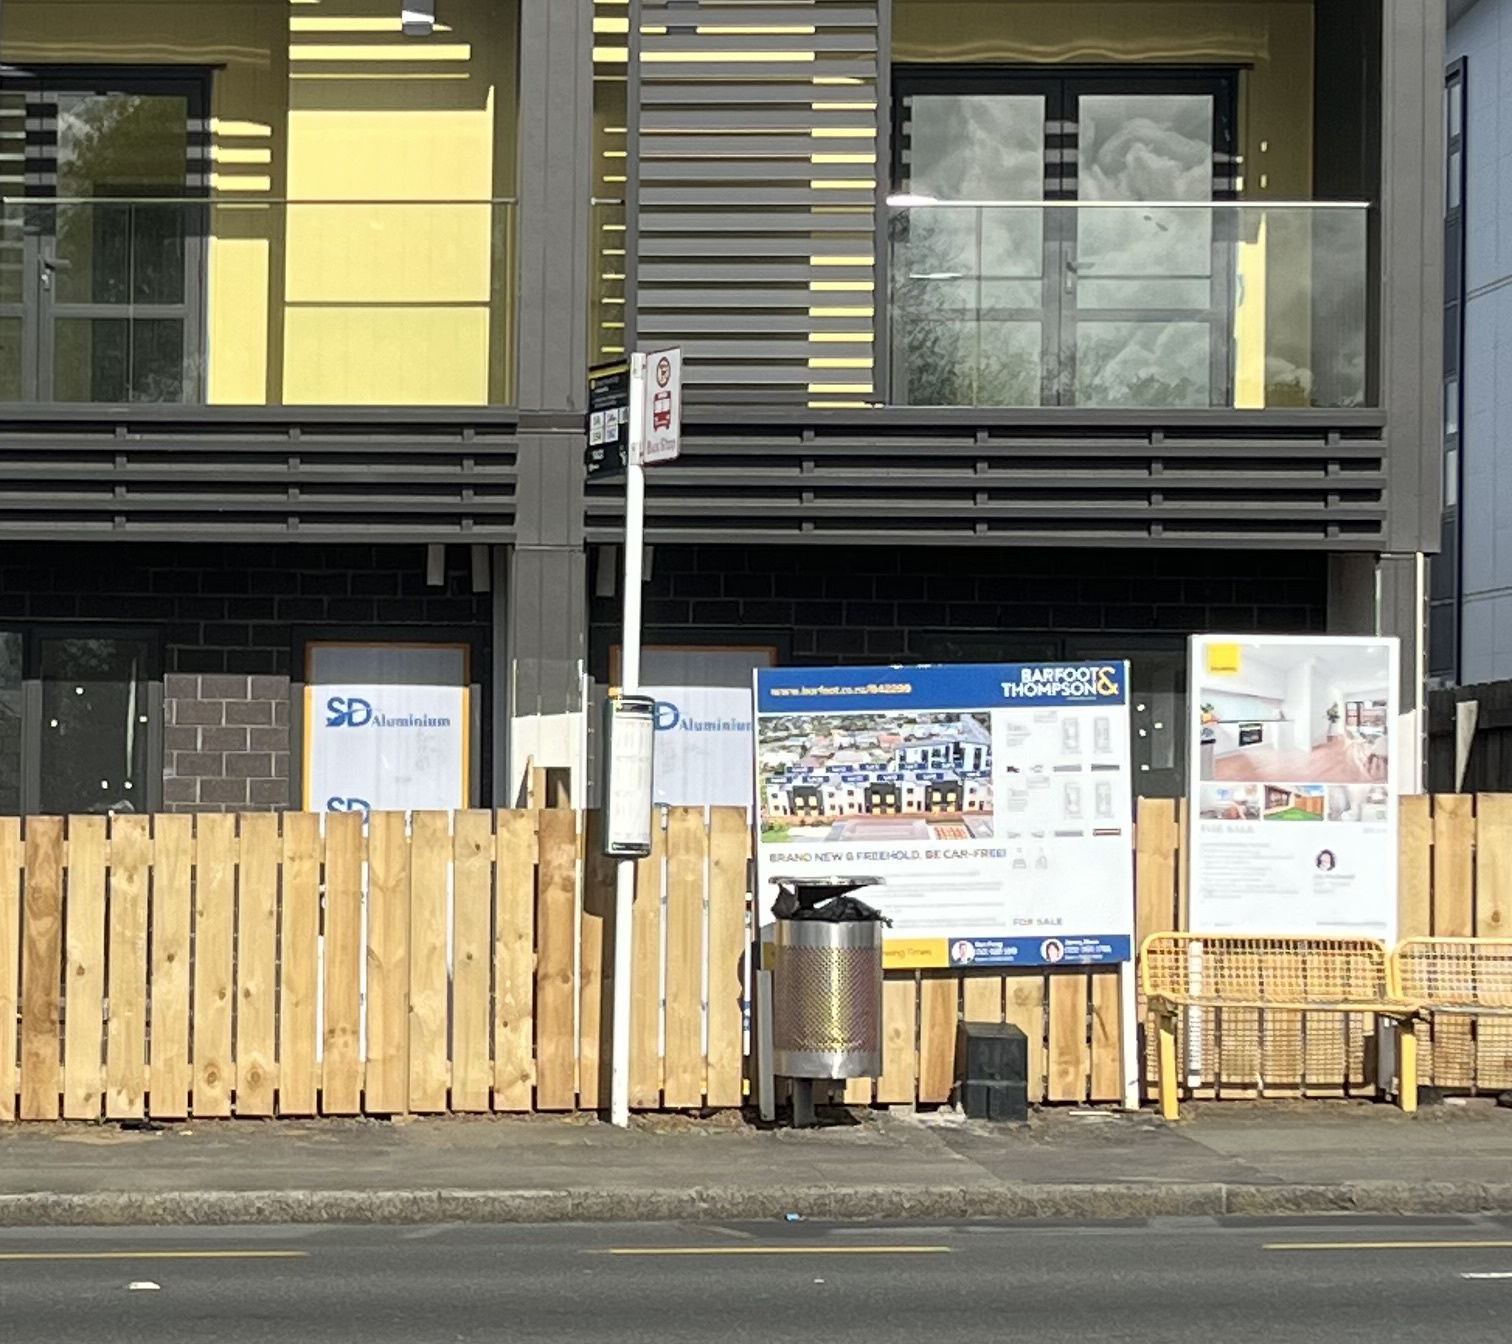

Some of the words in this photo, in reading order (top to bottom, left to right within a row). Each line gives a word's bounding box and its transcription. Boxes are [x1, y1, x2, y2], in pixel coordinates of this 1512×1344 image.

[1021, 667, 1099, 683] BARFOOT
[1097, 666, 1119, 696] &
[1001, 682, 1097, 698] THOMPSON
[325, 696, 372, 727] SD
[371, 713, 451, 727] Aluminium
[769, 853, 811, 863] BRAND
[815, 852, 842, 862] NEW
[1013, 918, 1033, 926] FOR
[1036, 917, 1062, 926] SALE
